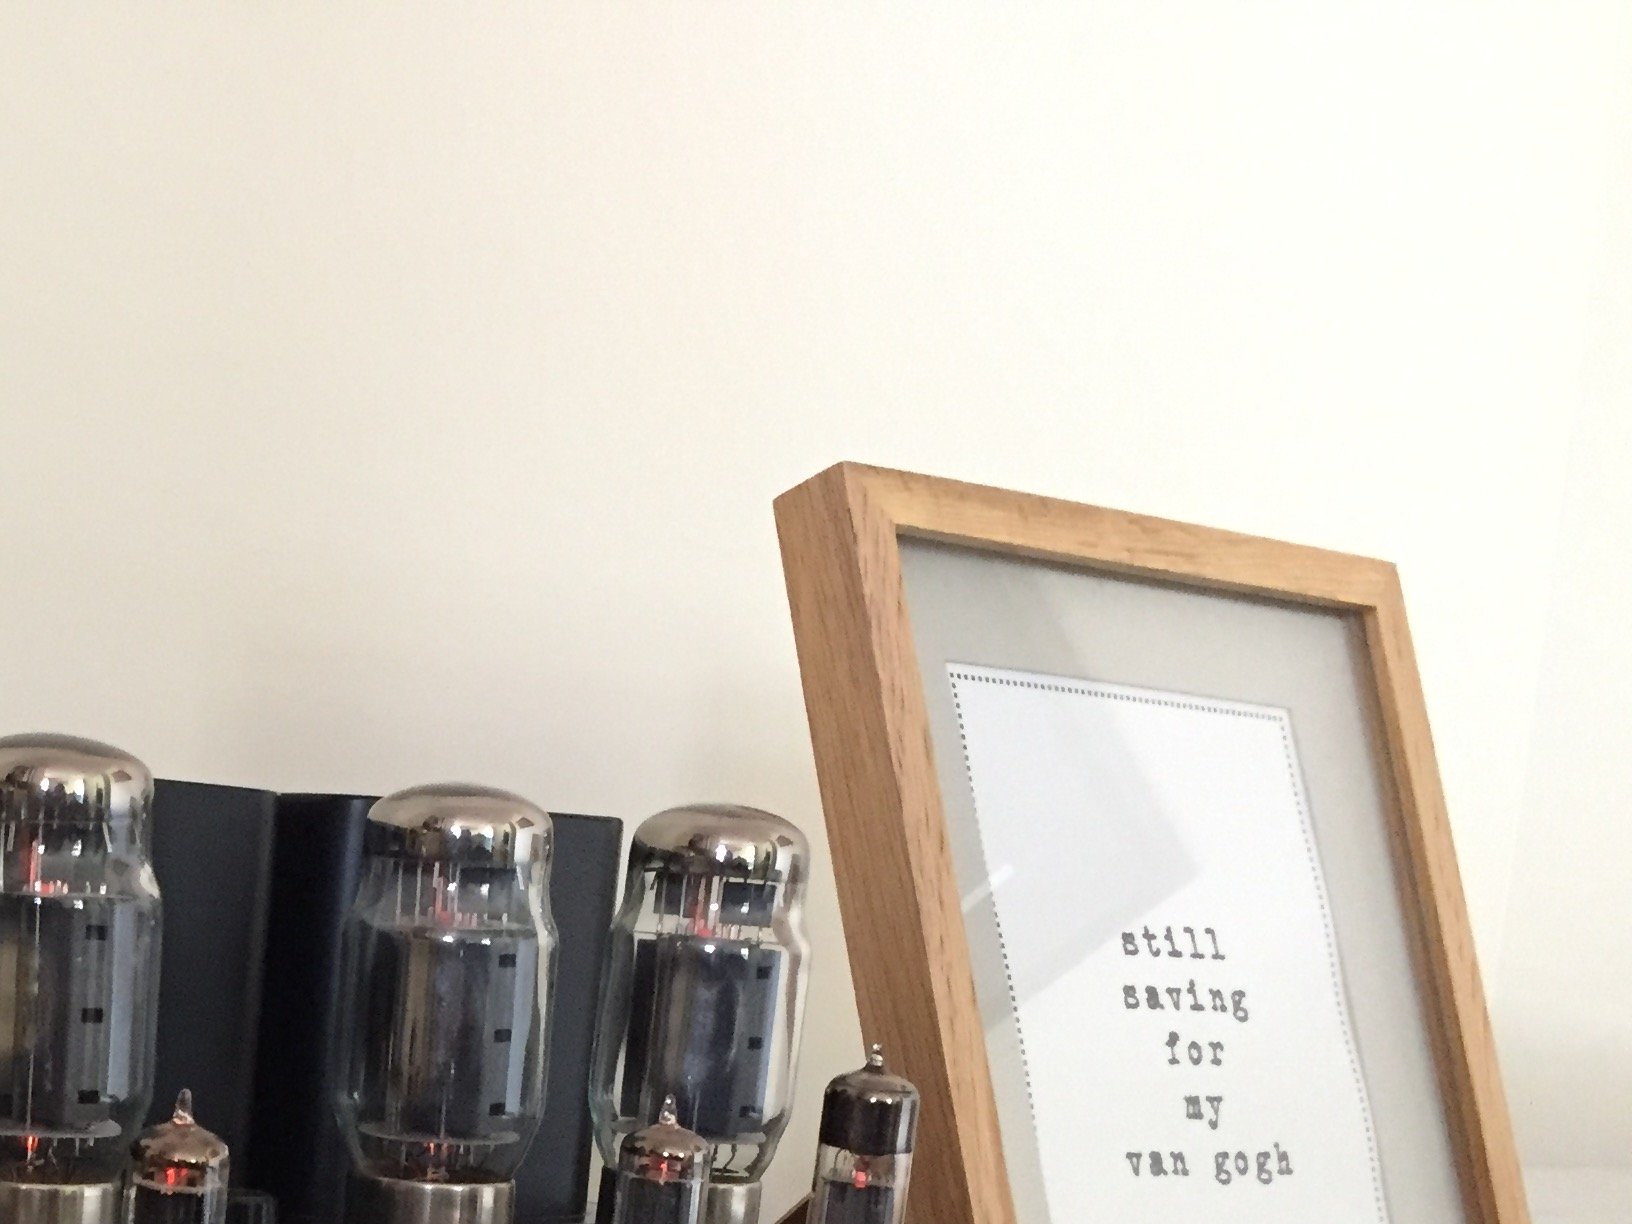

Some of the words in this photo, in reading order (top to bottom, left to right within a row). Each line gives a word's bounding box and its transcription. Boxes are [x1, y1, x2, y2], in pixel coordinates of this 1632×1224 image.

[1121, 926, 1226, 960] still
[1122, 978, 1250, 1023] saving
[1165, 1030, 1224, 1066] for
[1183, 1094, 1223, 1130] my
[1125, 1149, 1190, 1177] van
[1214, 1141, 1293, 1185] gogh
